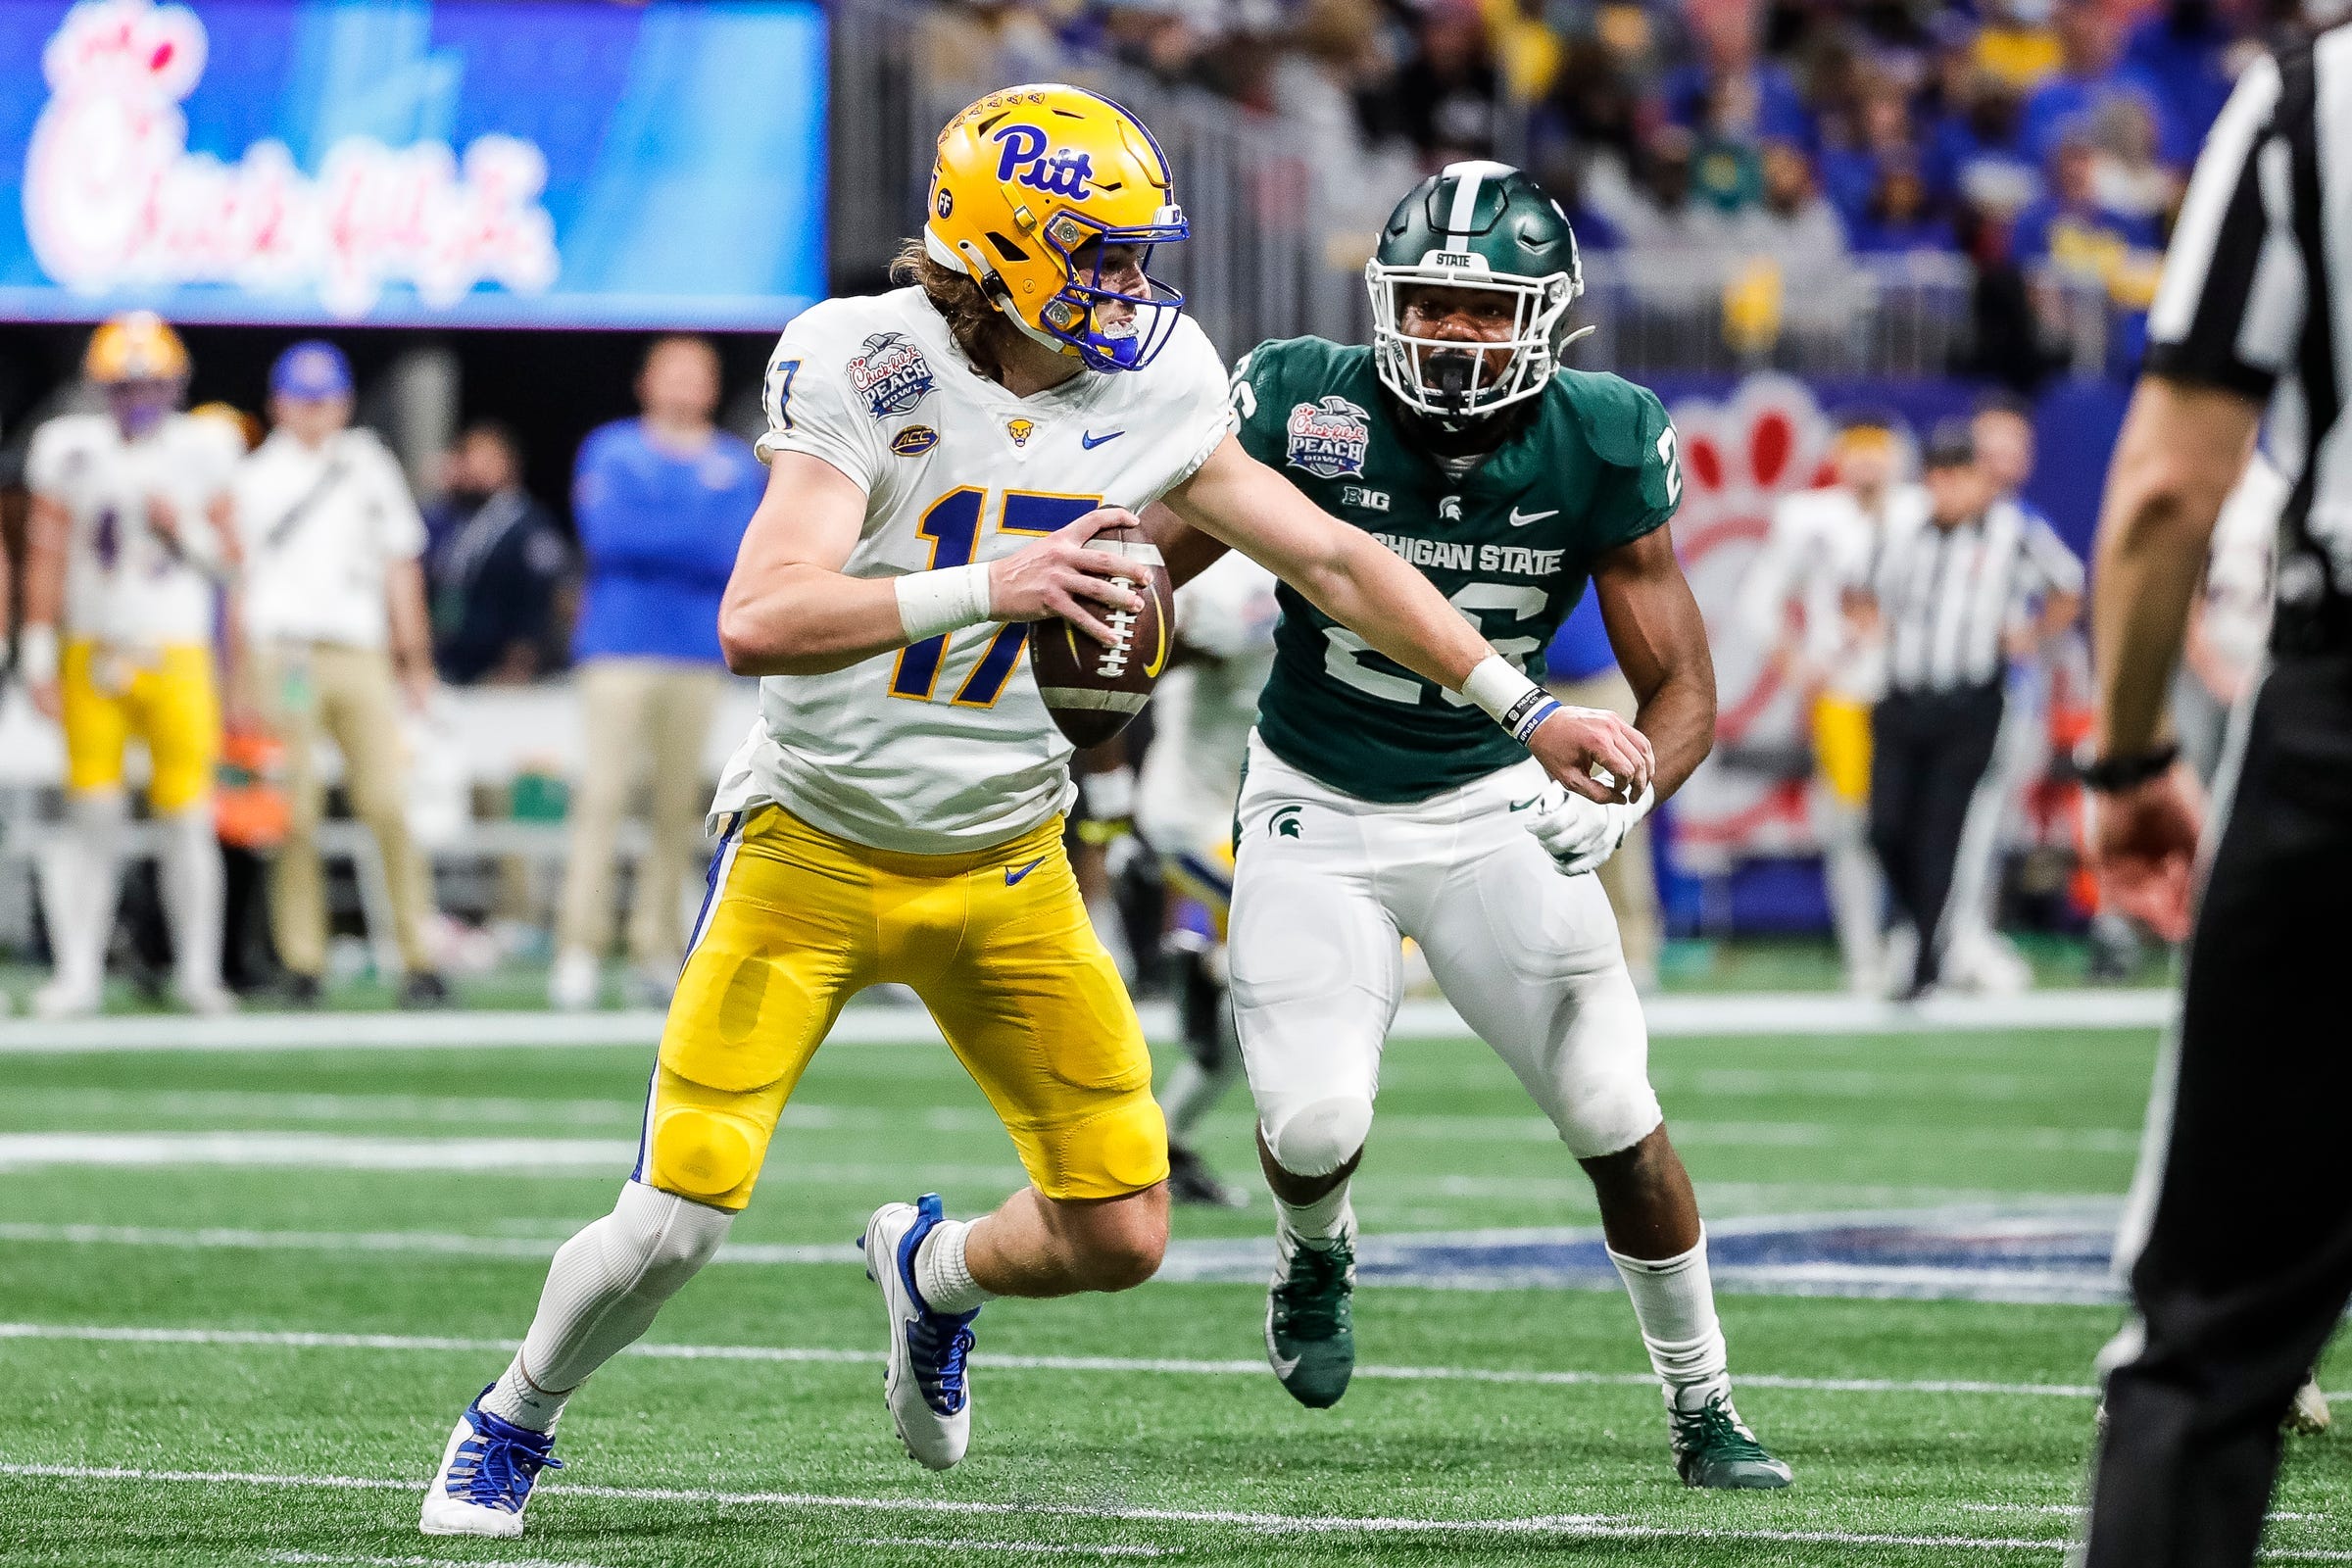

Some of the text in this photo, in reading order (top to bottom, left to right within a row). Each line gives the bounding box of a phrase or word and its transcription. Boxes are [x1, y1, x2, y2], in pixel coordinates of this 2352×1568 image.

[992, 123, 1094, 202] Pitt
[1436, 253, 1471, 268] STATE
[849, 345, 921, 391] Chick-fil-A
[764, 358, 804, 431] 7
[862, 359, 932, 413] PEACH
[882, 383, 922, 409] BOWL
[896, 429, 932, 447] ACC
[1293, 408, 1365, 443] Chick-fil-A
[1291, 436, 1363, 463] PEACH
[1303, 455, 1348, 466] BOWL
[1479, 545, 1566, 575] STATE
